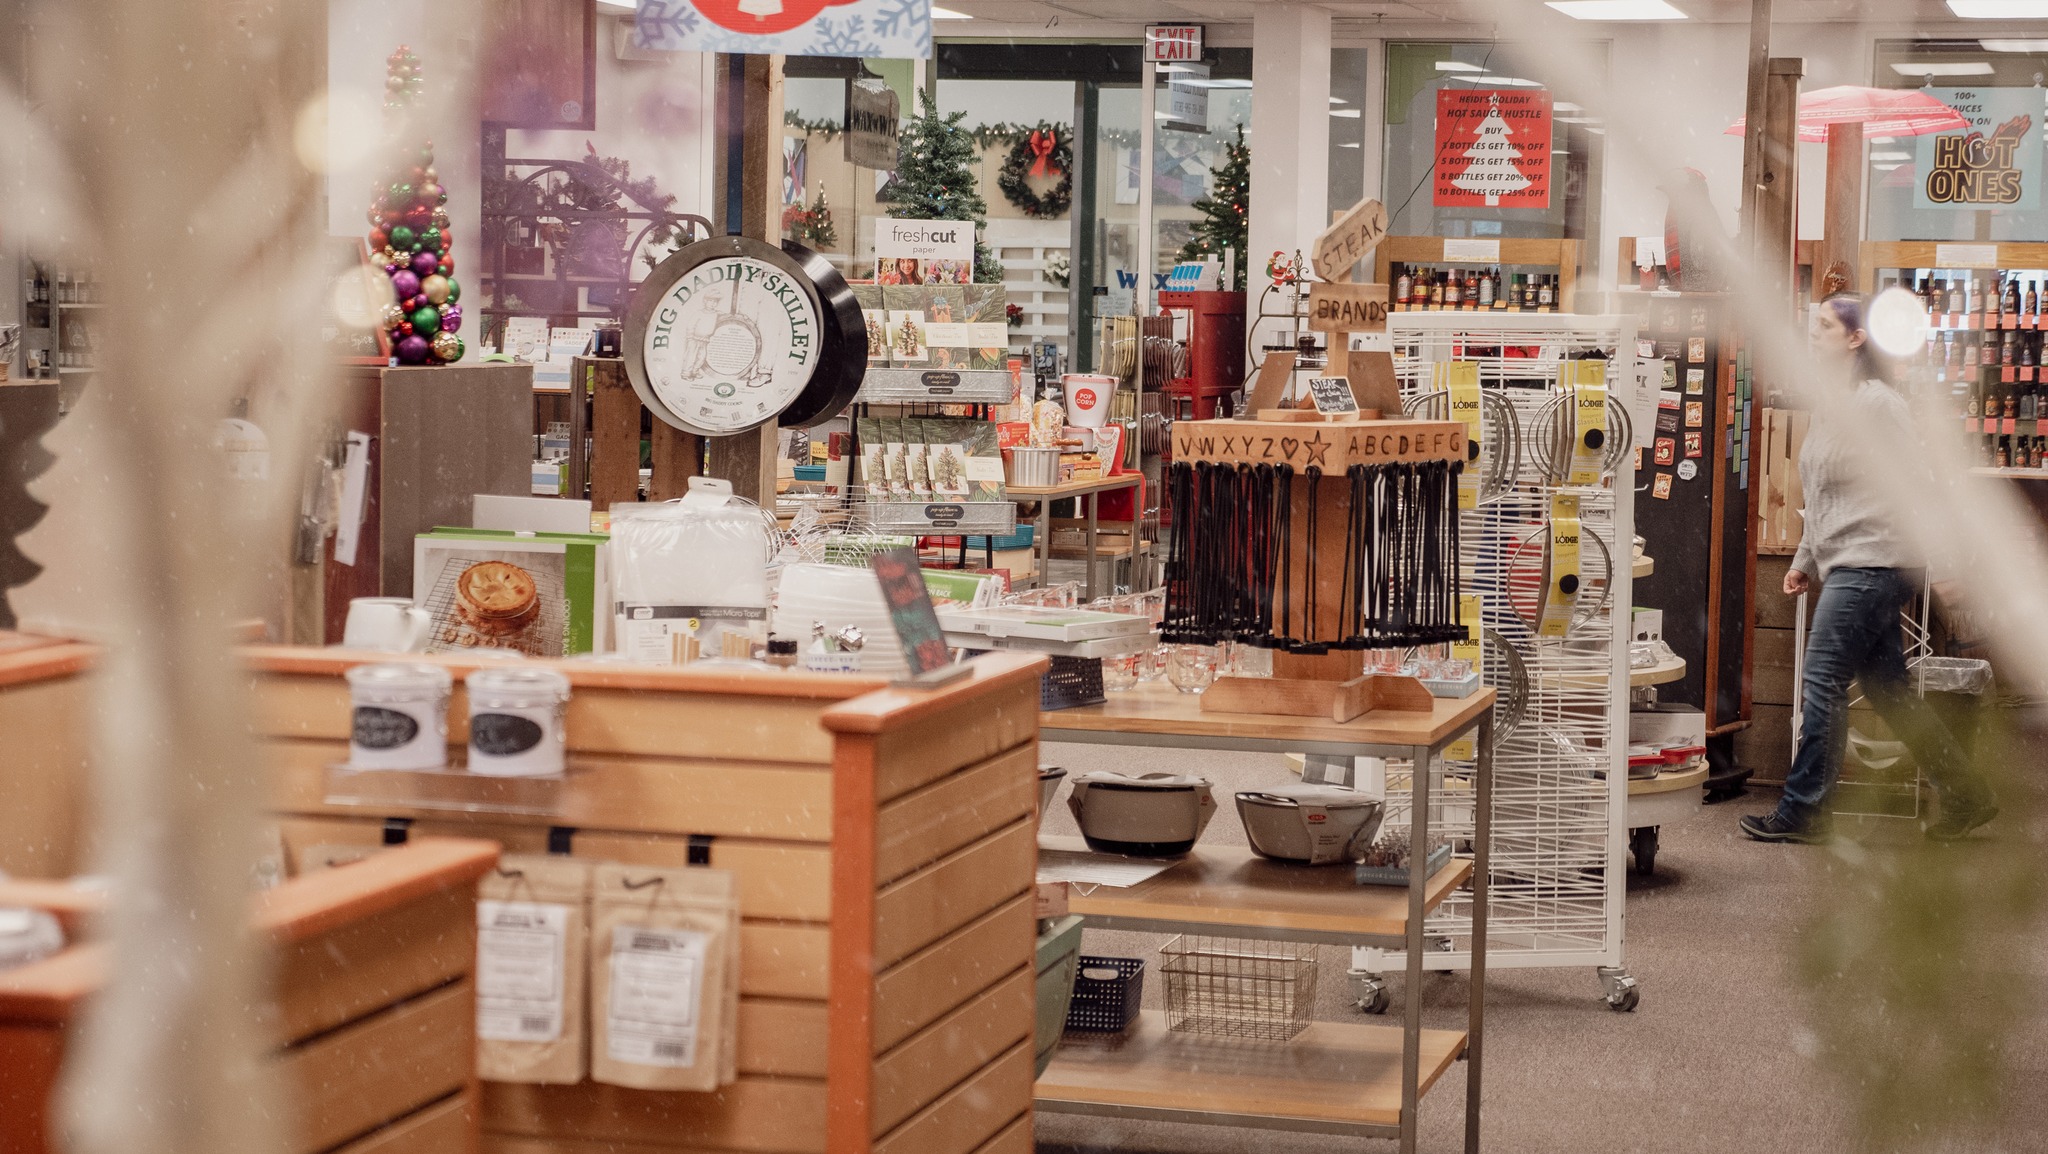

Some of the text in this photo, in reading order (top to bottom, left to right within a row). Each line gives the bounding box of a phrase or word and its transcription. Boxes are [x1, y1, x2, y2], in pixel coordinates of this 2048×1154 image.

[1154, 28, 1196, 59] EXIT
[1458, 95, 1531, 104] HEIDI'S HOLIDAY
[1954, 92, 1976, 100] 100+
[1446, 109, 1542, 119] HOT SAUCE HUSTLE
[1976, 117, 1992, 126] ON
[1484, 127, 1503, 135] BUY
[1449, 141, 1486, 150] BOTTLES
[1488, 142, 1505, 150] GET
[1507, 142, 1525, 150] 10%
[1527, 143, 1545, 151] OFF
[1935, 135, 2020, 169] HOT
[1440, 157, 1544, 166] 5 BOTTLES GET 15% OFF
[1440, 172, 1543, 182] 8 BOTTLES GET 20% OFF
[1926, 168, 2023, 204] ONES
[1438, 188, 1545, 197] 10 BOTTLES GET 25% OFF
[891, 225, 957, 243] freshcut
[1323, 213, 1383, 275] STEAK
[912, 247, 936, 255] paper
[1115, 269, 1172, 290] WX
[653, 308, 678, 350] BIG
[673, 262, 762, 306] DADDY
[762, 275, 810, 366] SKILLET
[1317, 298, 1388, 325] BRANDS
[1079, 392, 1093, 400] POP
[1076, 398, 1095, 406] CORN
[1453, 400, 1479, 410] LODGE
[1578, 399, 1604, 408] LODGE
[1555, 535, 1579, 544] LODGE
[562, 598, 571, 637] COOLING
[722, 609, 743, 618] Micro
[689, 619, 697, 628] 2
